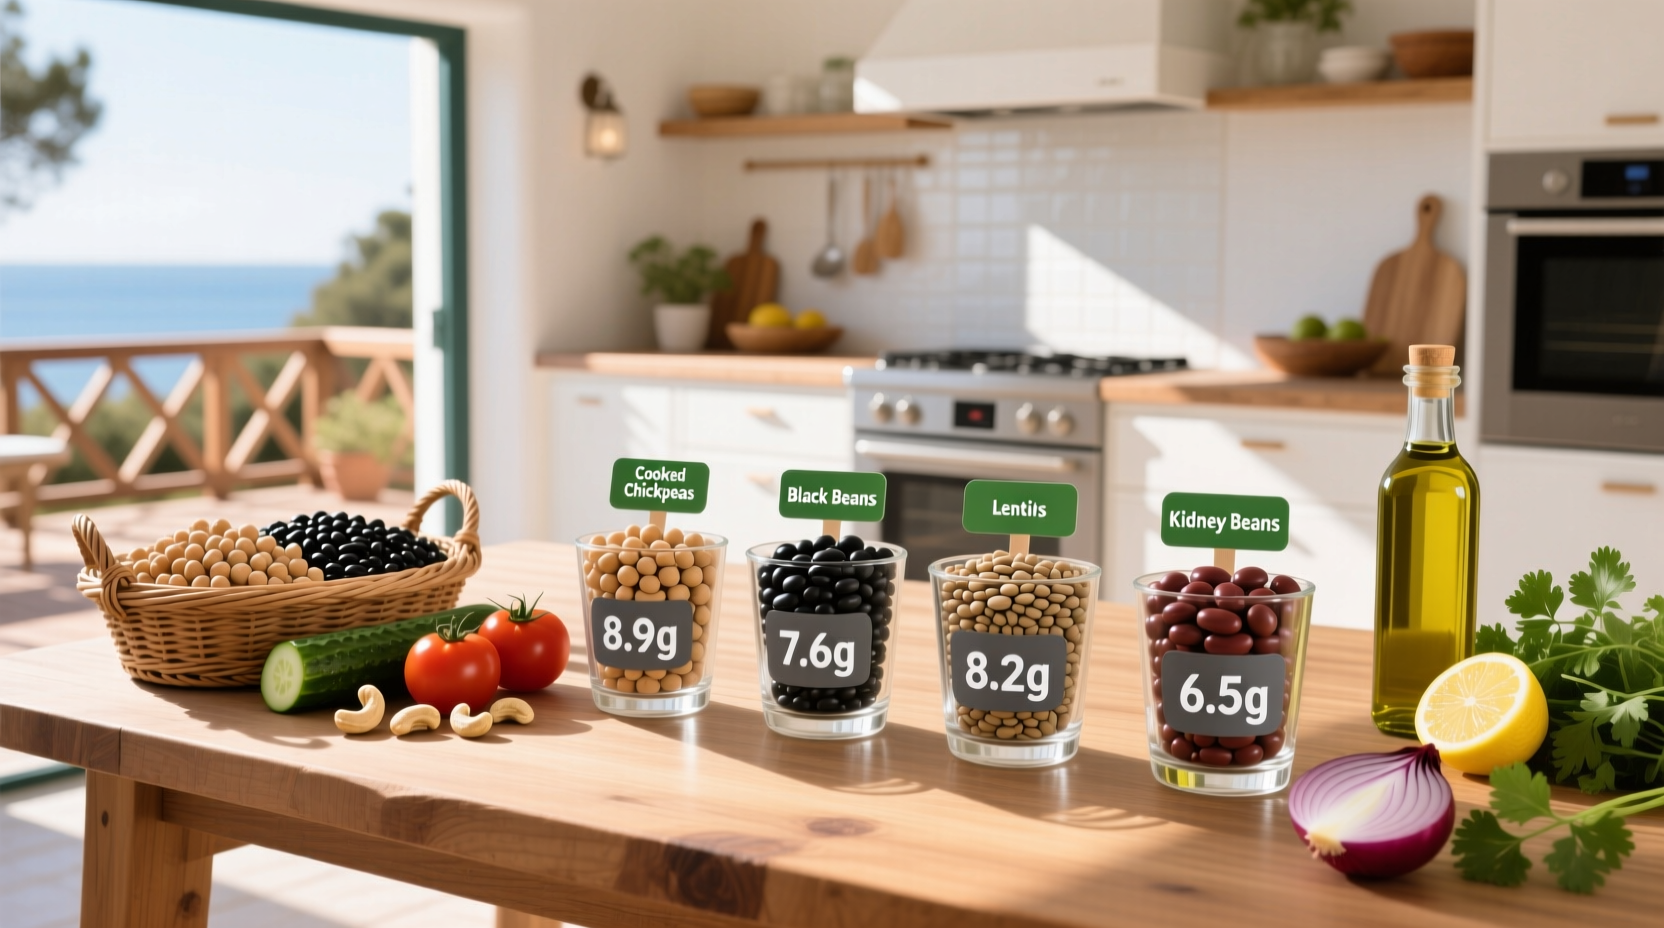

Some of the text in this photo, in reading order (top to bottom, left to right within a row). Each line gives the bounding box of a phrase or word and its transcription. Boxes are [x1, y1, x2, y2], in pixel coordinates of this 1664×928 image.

[635, 465, 687, 483] Cooked
[624, 482, 695, 503] Chickpeas
[787, 486, 878, 507] Black Beans
[1169, 510, 1281, 535] Kidney Beans
[602, 615, 678, 661] 8.9g
[779, 629, 856, 678] 7.6g
[965, 650, 1050, 703] 8.2g
[1179, 673, 1269, 726] 6.5g
